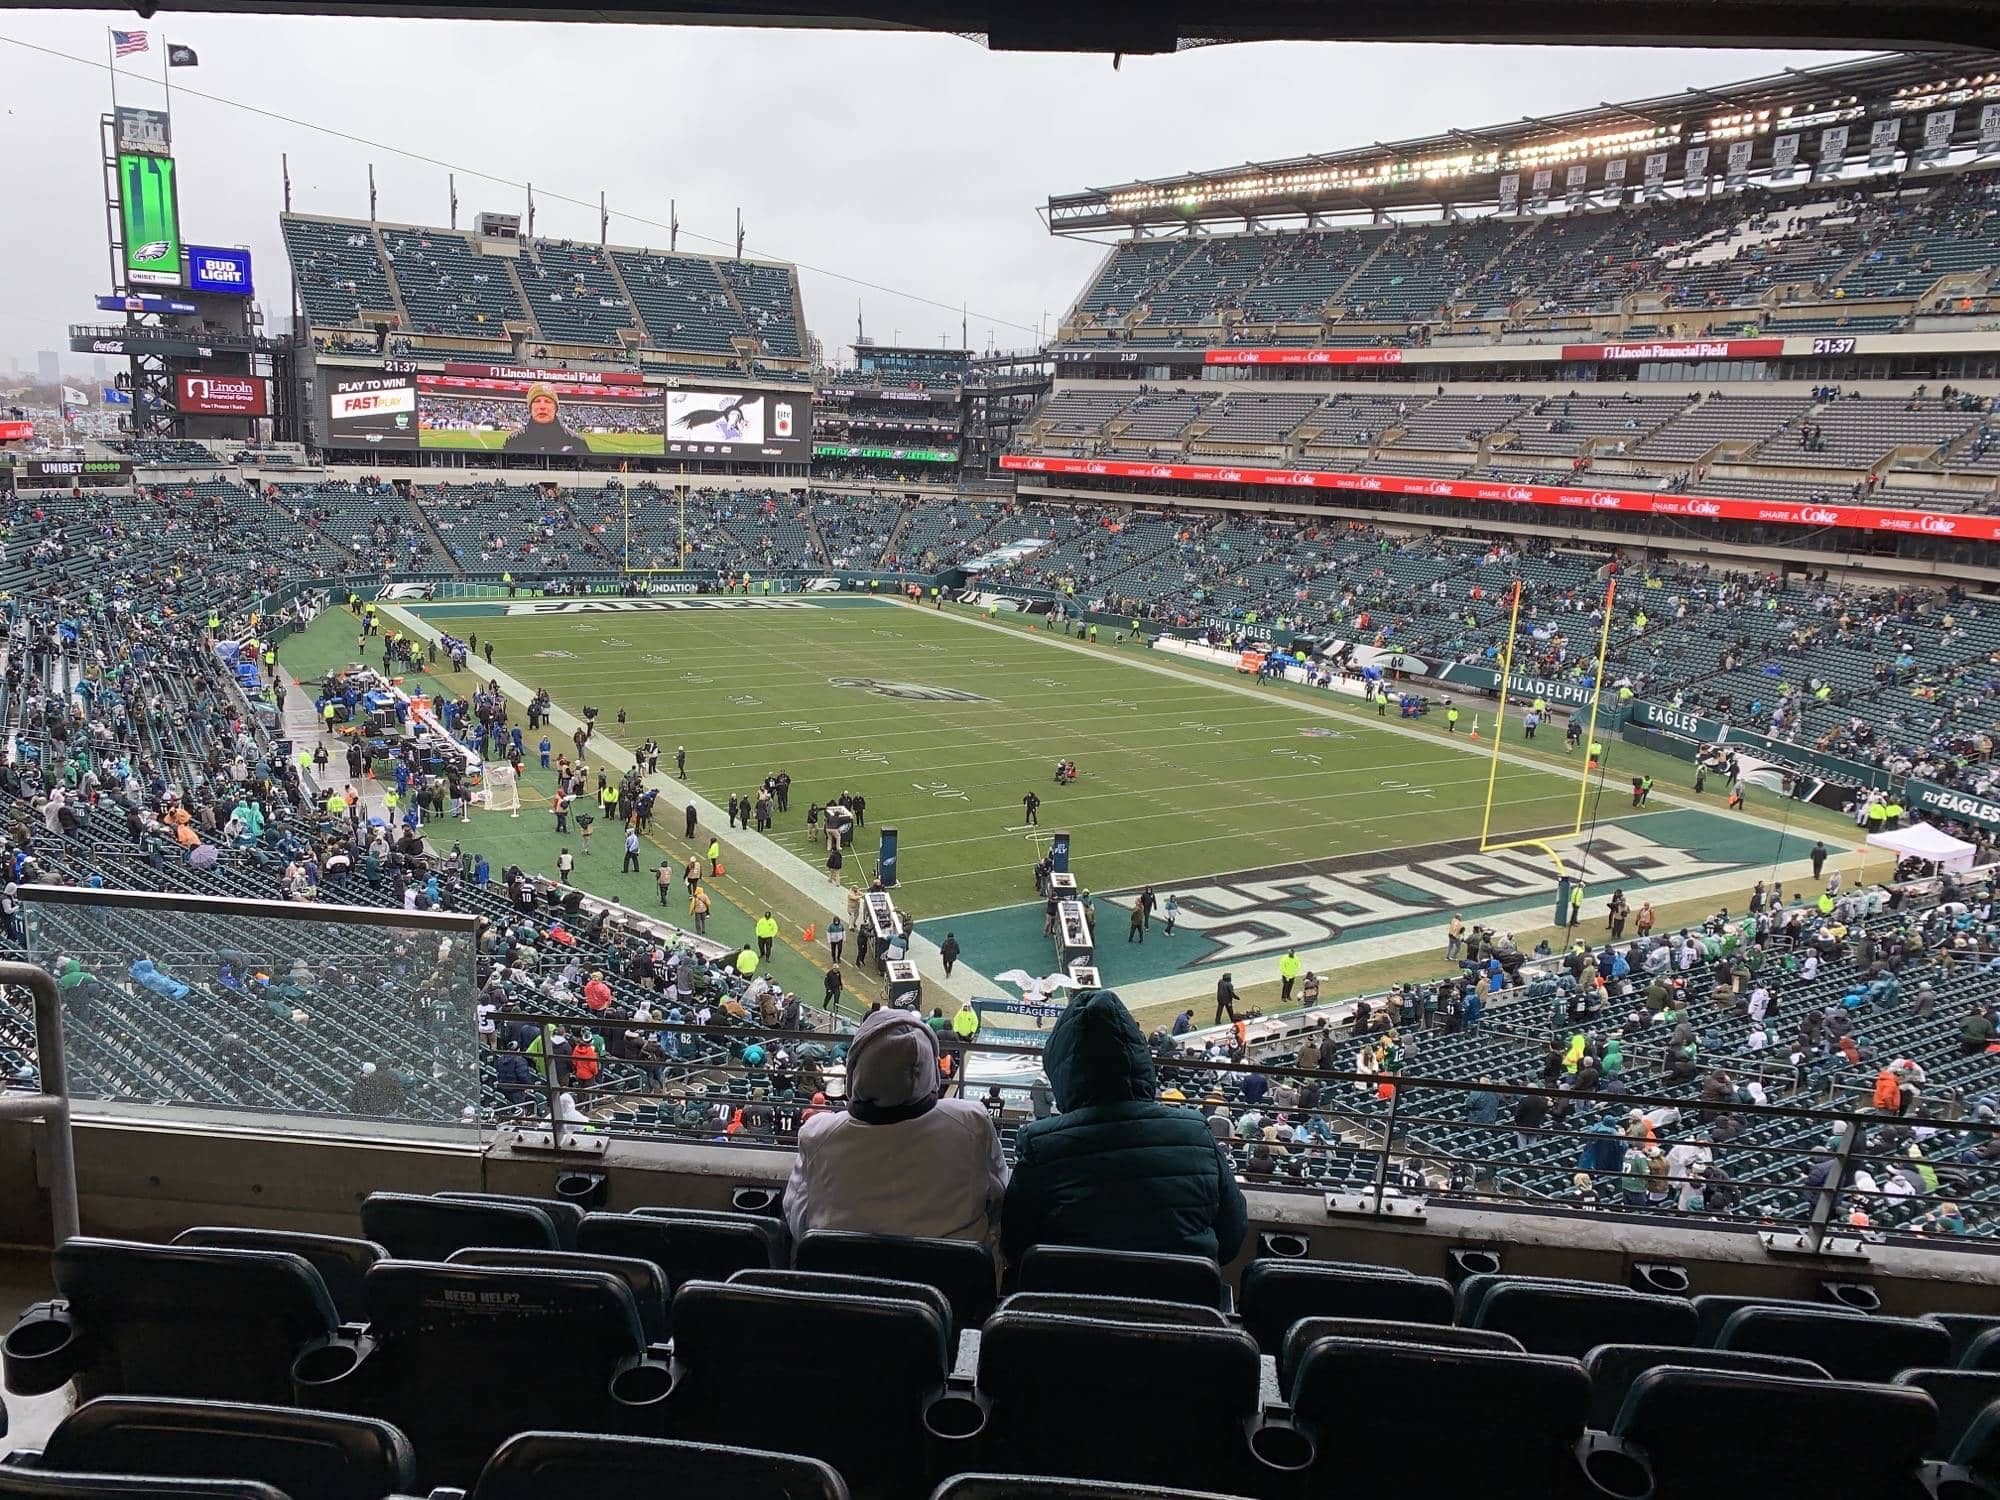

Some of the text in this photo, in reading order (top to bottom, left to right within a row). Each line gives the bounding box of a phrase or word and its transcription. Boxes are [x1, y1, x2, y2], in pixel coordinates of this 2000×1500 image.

[205, 260, 236, 271] BUD
[201, 269, 241, 282] LIGHT
[1614, 343, 1728, 358] Lincoln Financial Field
[1814, 339, 1854, 353] 21:37
[1238, 351, 1259, 361] Coke
[1308, 351, 1329, 361] Coke
[385, 361, 416, 373] 21:37
[501, 367, 602, 383] Lincoln Financial Field
[209, 380, 253, 392] Lincoln
[338, 377, 406, 392] PLAY TO WIN!
[777, 410, 790, 420] Lite
[41, 463, 83, 473] UNIBET
[1219, 470, 1241, 481] Coke
[1293, 474, 1316, 485] Coke
[1360, 477, 1381, 489] Coke
[1430, 482, 1453, 495] Coke
[1478, 489, 1499, 498] SHARE
[1507, 487, 1532, 500] Coke
[1559, 495, 1583, 504] SHARE
[1591, 492, 1620, 506] Coke
[1652, 502, 1679, 512] SHARE
[1687, 500, 1720, 514] Coke
[1760, 510, 1790, 520] SHARE
[1800, 507, 1838, 523] Coke
[1880, 518, 1912, 529] SHARE
[1921, 516, 1955, 532] Coke
[506, 600, 821, 615] EAGLES
[1494, 674, 1597, 704] PHILADELPHIA
[1648, 706, 1698, 732] EAGLES
[1922, 791, 2000, 822] FLY EAGLES
[1020, 1006, 1056, 1017] EAGLES
[680, 1033, 691, 1044] 62
[1394, 1048, 1404, 1062] 12
[752, 1115, 761, 1126] 11
[780, 1117, 792, 1130] 11
[444, 1290, 520, 1303] NEED HELP?
